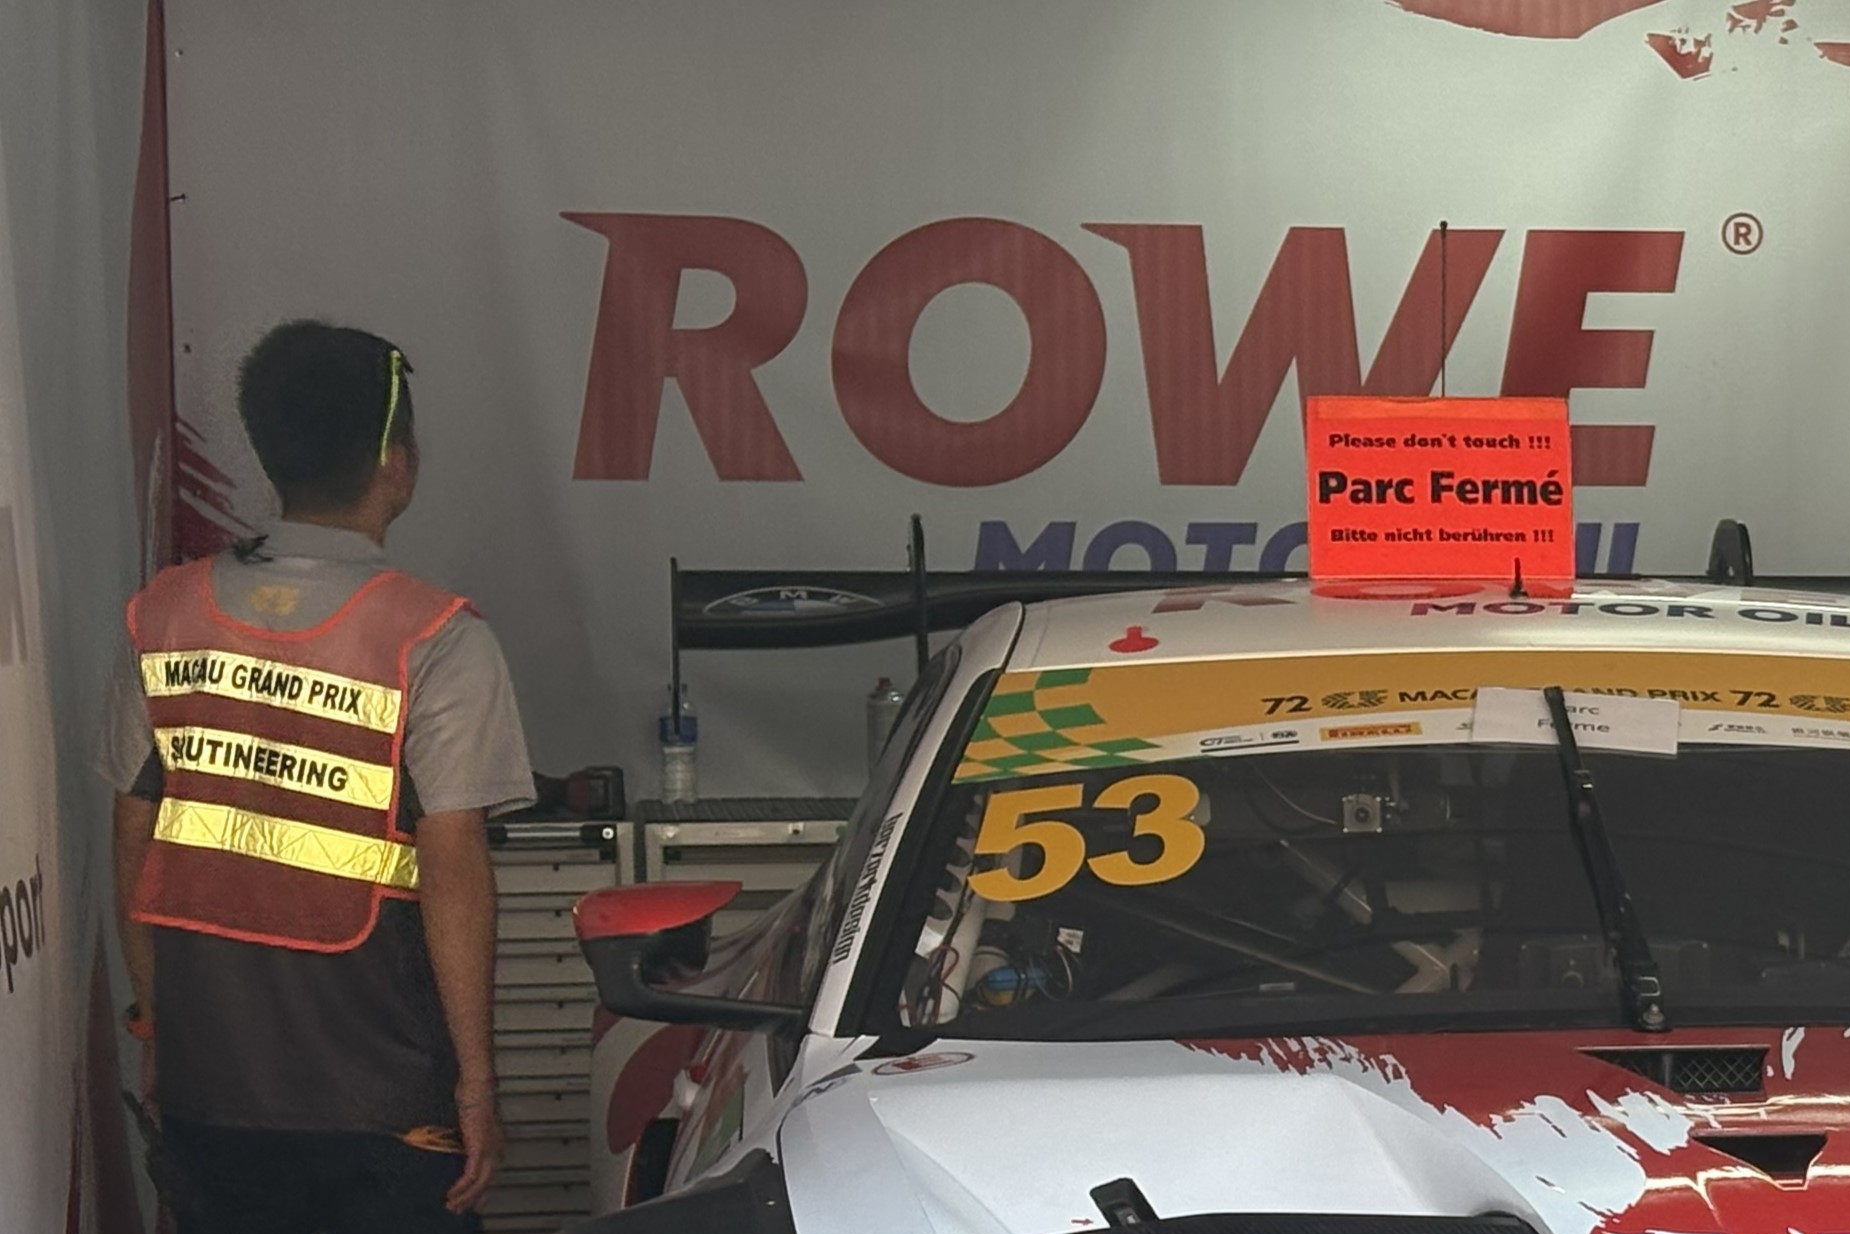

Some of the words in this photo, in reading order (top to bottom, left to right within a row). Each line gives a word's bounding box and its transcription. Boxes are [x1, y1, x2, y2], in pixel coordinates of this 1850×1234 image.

[559, 212, 1685, 487] ROWE
[1329, 433, 1396, 448] Please
[1463, 434, 1520, 449] touch
[1318, 471, 1415, 504] Parc
[1430, 469, 1564, 506] Fermé
[1330, 529, 1378, 542] Bitte
[1384, 529, 1432, 542] nicht
[1438, 528, 1526, 543] berühren
[1410, 601, 1714, 620] MOTOR
[231, 664, 303, 701] GRAND
[308, 680, 363, 715] PRIX
[1261, 695, 1312, 715] 72
[1729, 690, 1780, 709] 72
[967, 774, 1206, 903] 53
